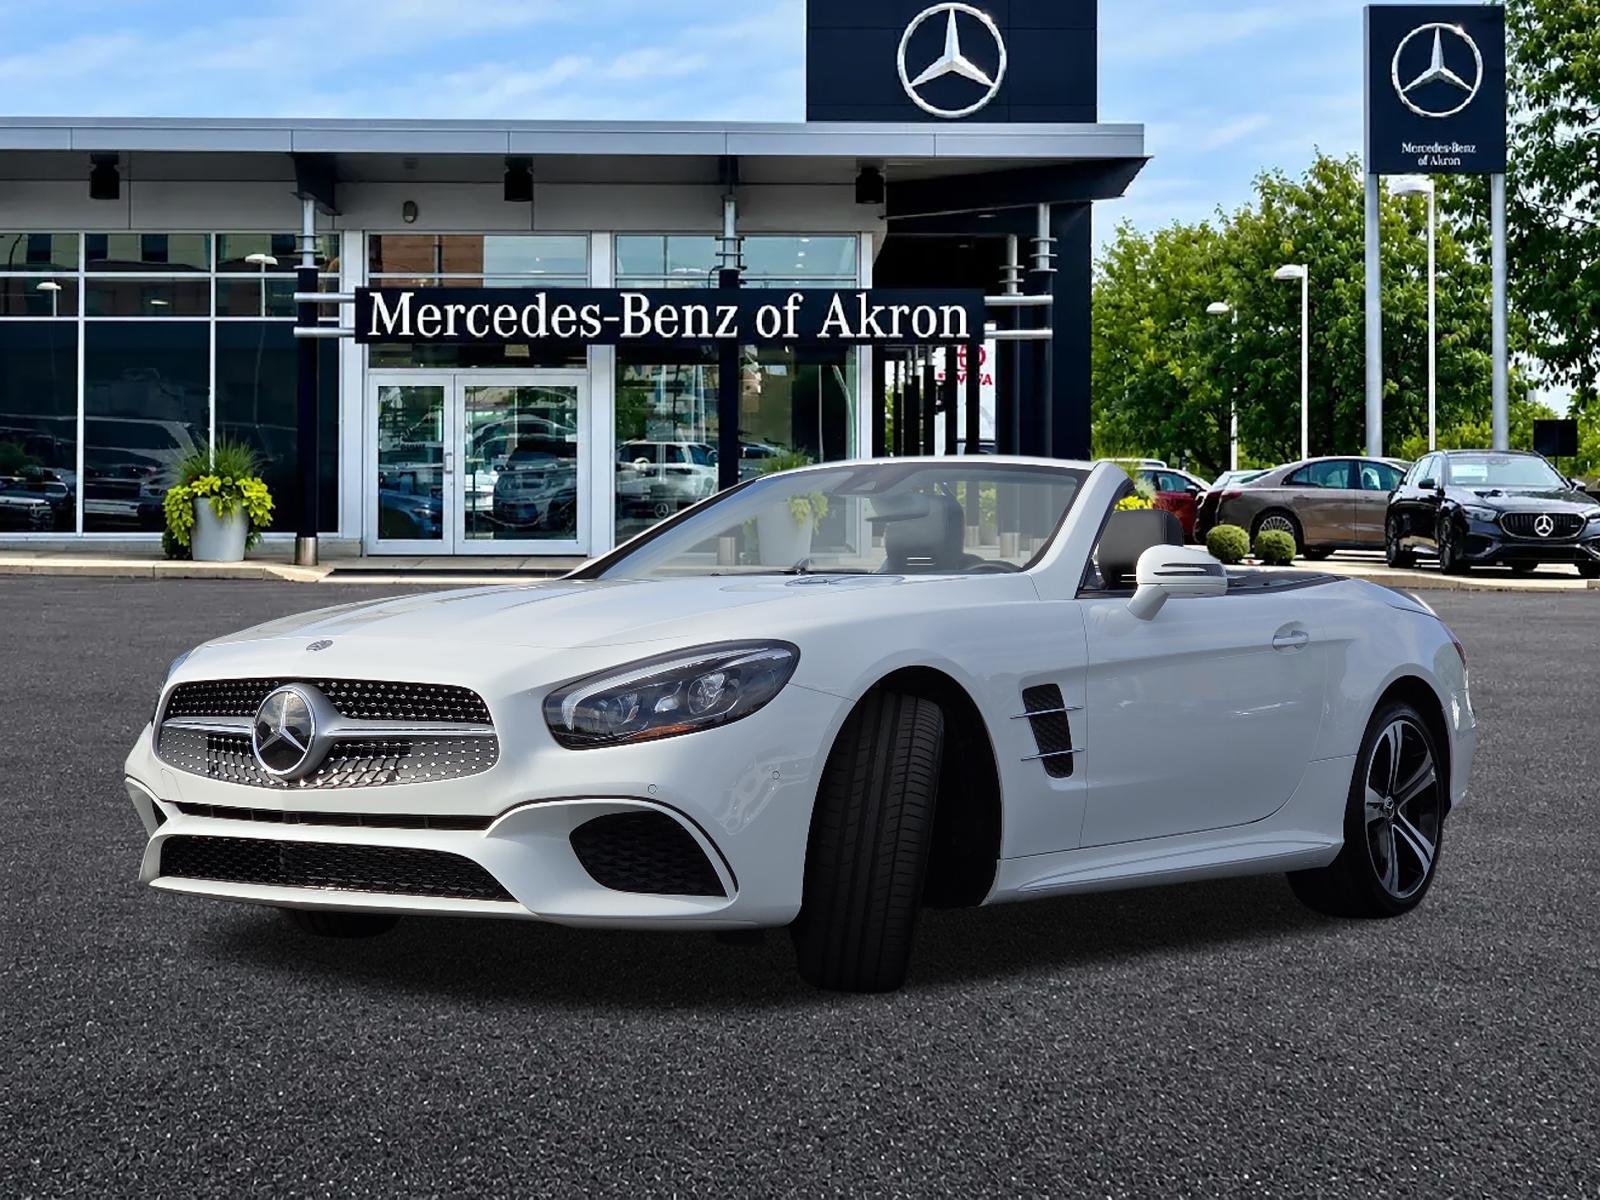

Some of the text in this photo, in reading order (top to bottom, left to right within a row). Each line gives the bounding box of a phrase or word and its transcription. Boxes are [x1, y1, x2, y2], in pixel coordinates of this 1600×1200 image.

[1401, 141, 1477, 154] Mercedes-Benz
[1418, 154, 1461, 166] of Akron
[367, 290, 971, 338] Mercedes-Benz of Akron
